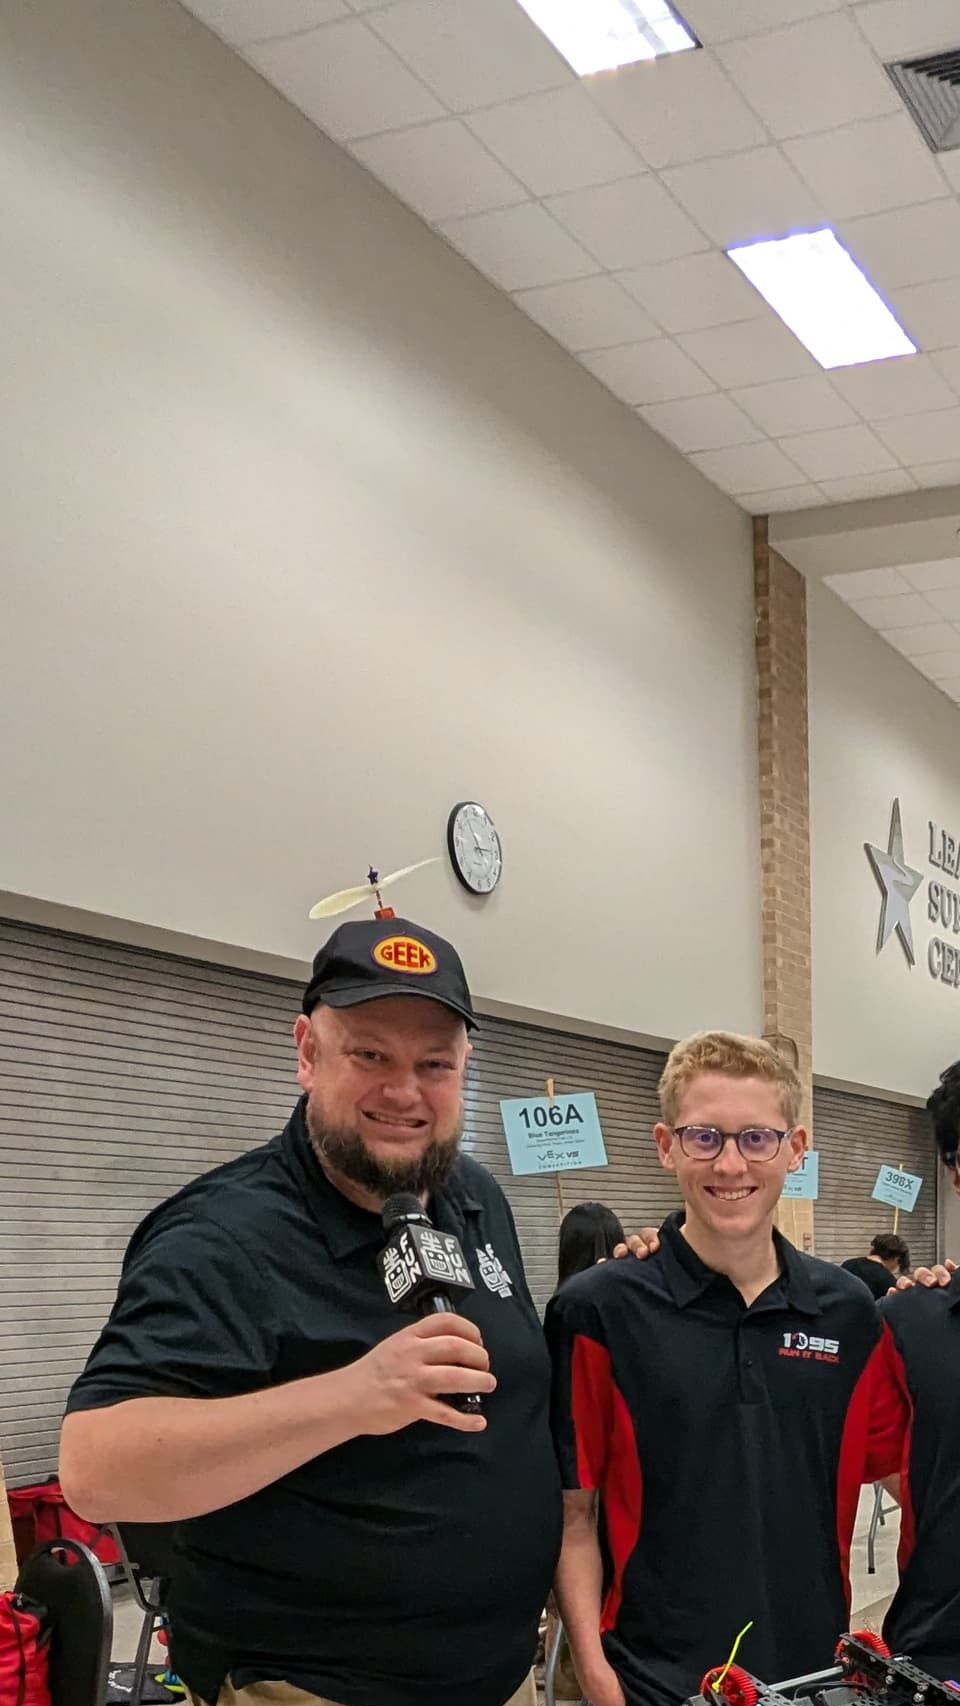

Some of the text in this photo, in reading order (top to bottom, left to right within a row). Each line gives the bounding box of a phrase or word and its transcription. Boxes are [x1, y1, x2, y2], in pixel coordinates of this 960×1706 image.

[380, 941, 431, 969] GEEK
[518, 1103, 585, 1129] 106A
[885, 1171, 916, 1191] 398X
[400, 1232, 423, 1284] FUN
[444, 1237, 471, 1284] FUN
[783, 1332, 840, 1354] 1095
